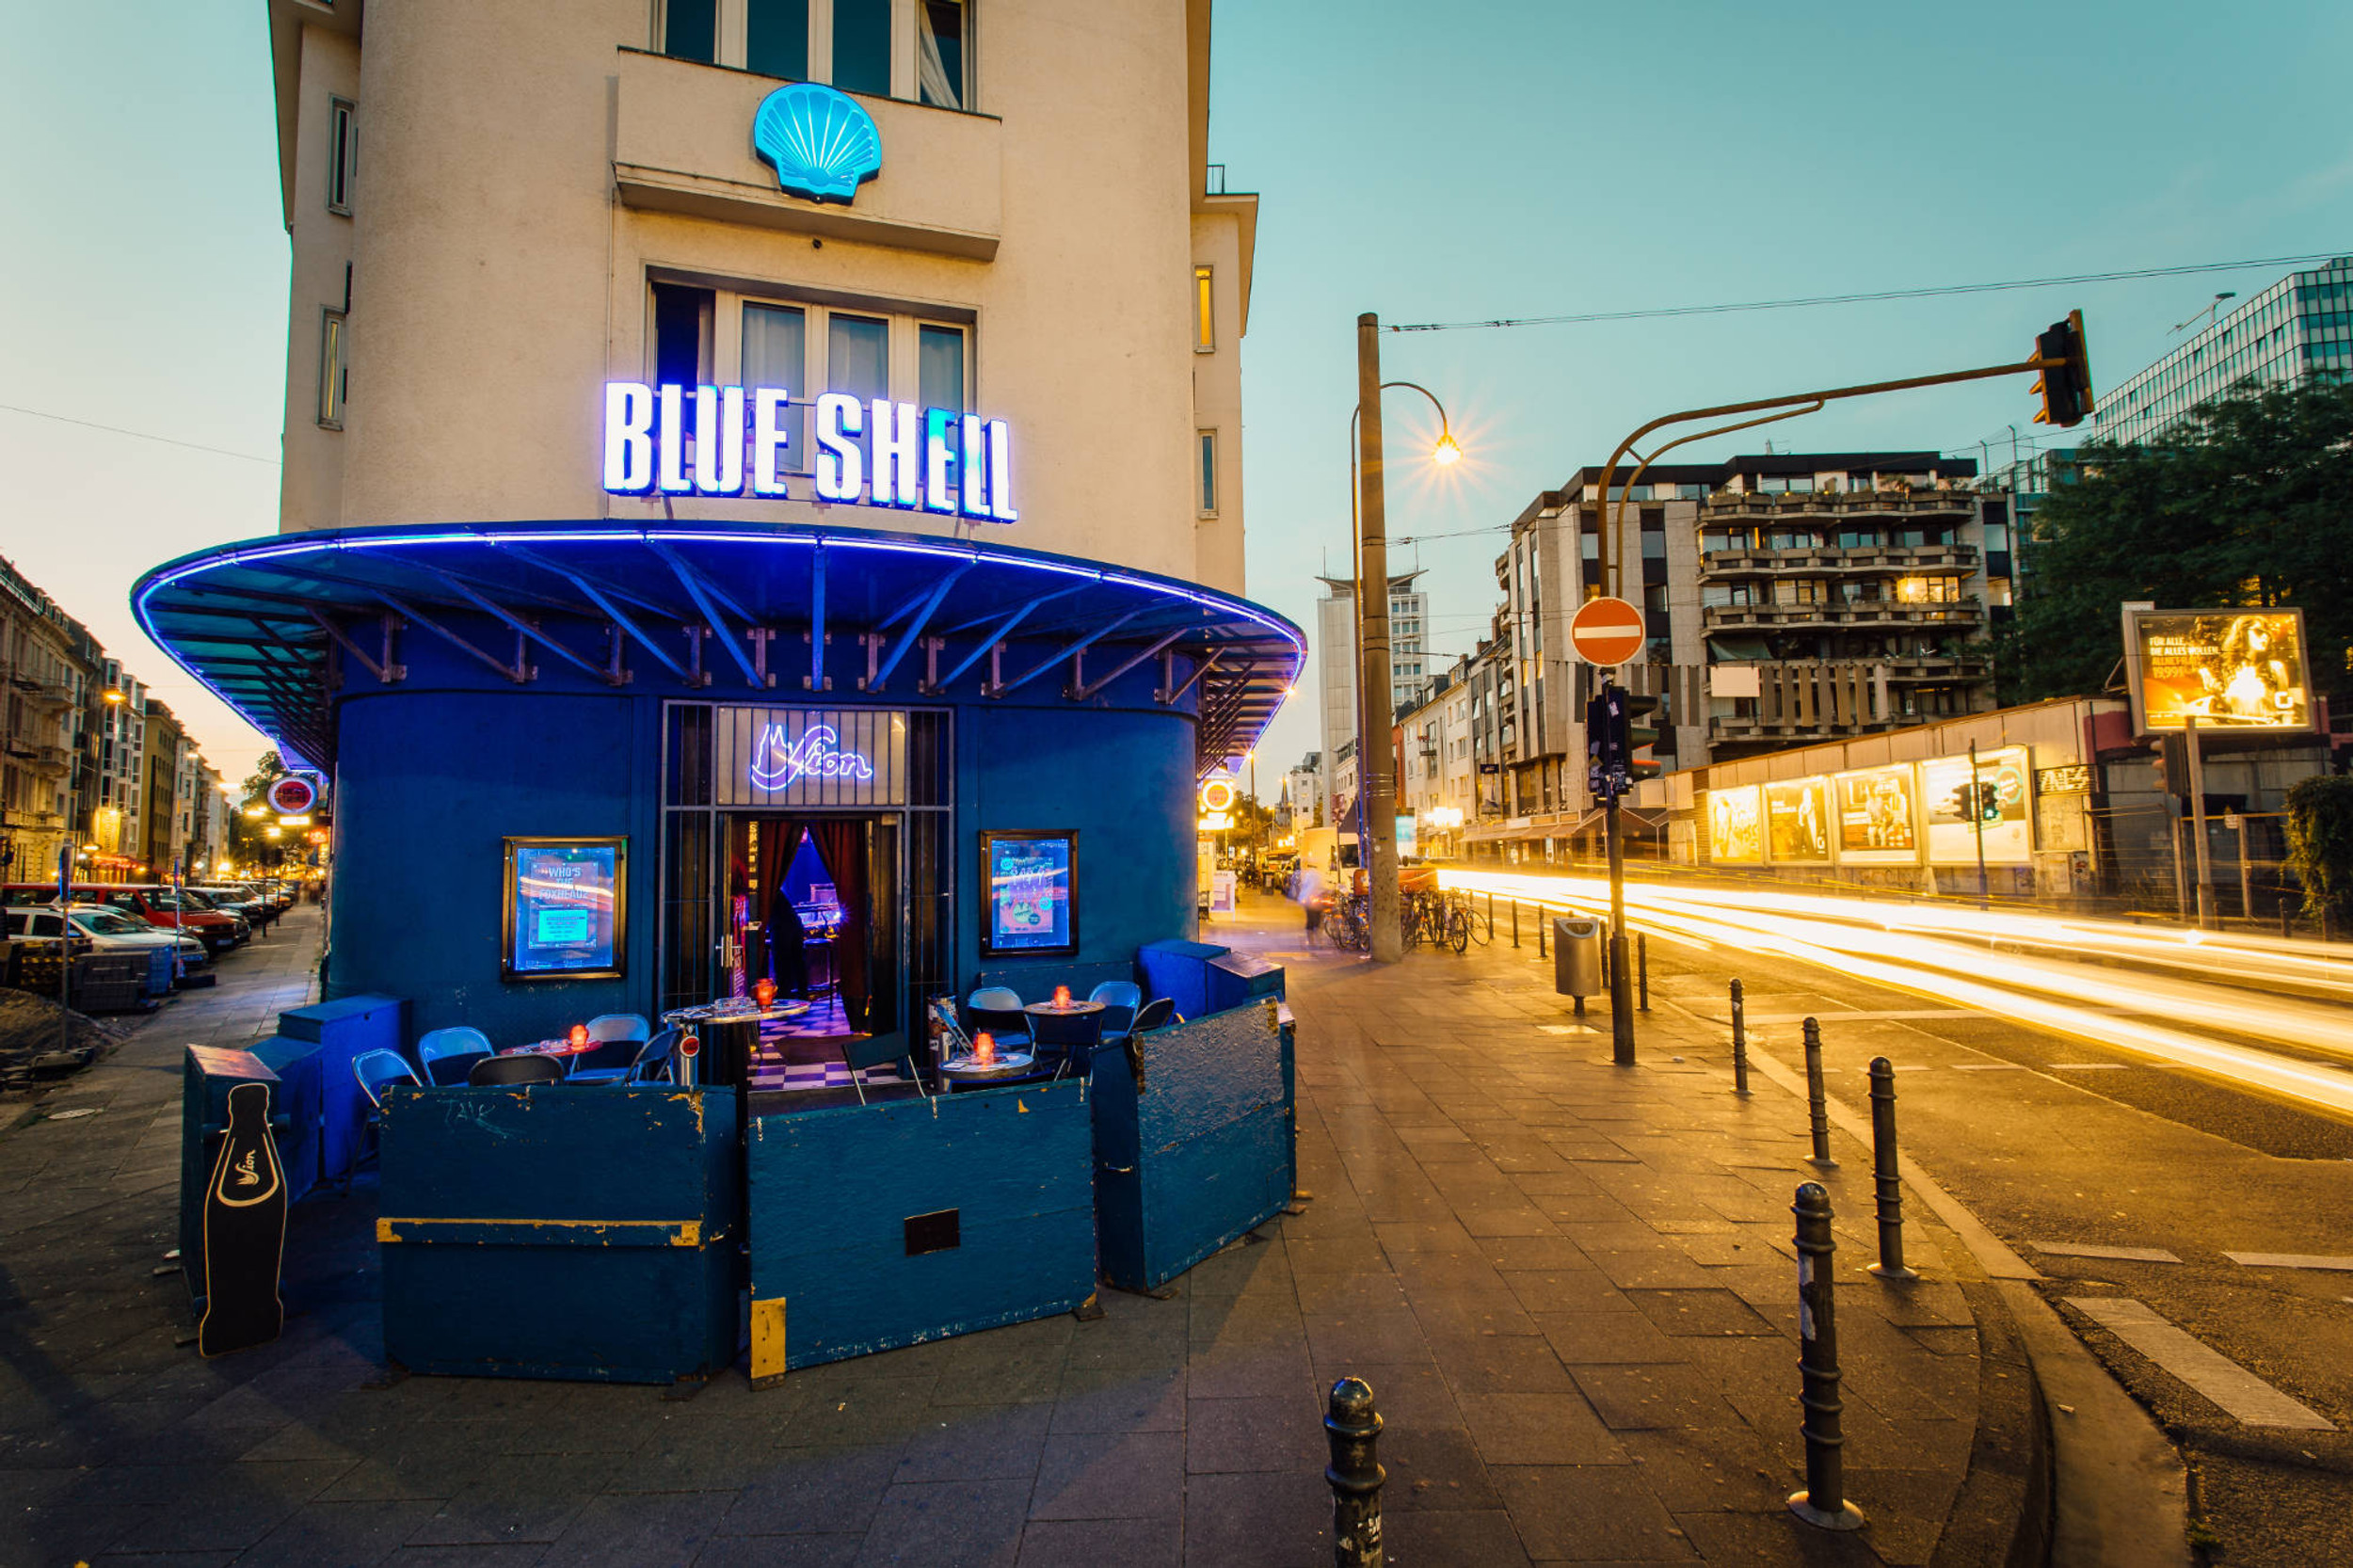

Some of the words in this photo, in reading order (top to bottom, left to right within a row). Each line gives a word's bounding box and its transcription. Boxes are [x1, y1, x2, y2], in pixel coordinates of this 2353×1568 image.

[603, 381, 789, 497] BLUE
[815, 392, 1019, 523] SHELL
[549, 867, 582, 877] WHO'S
